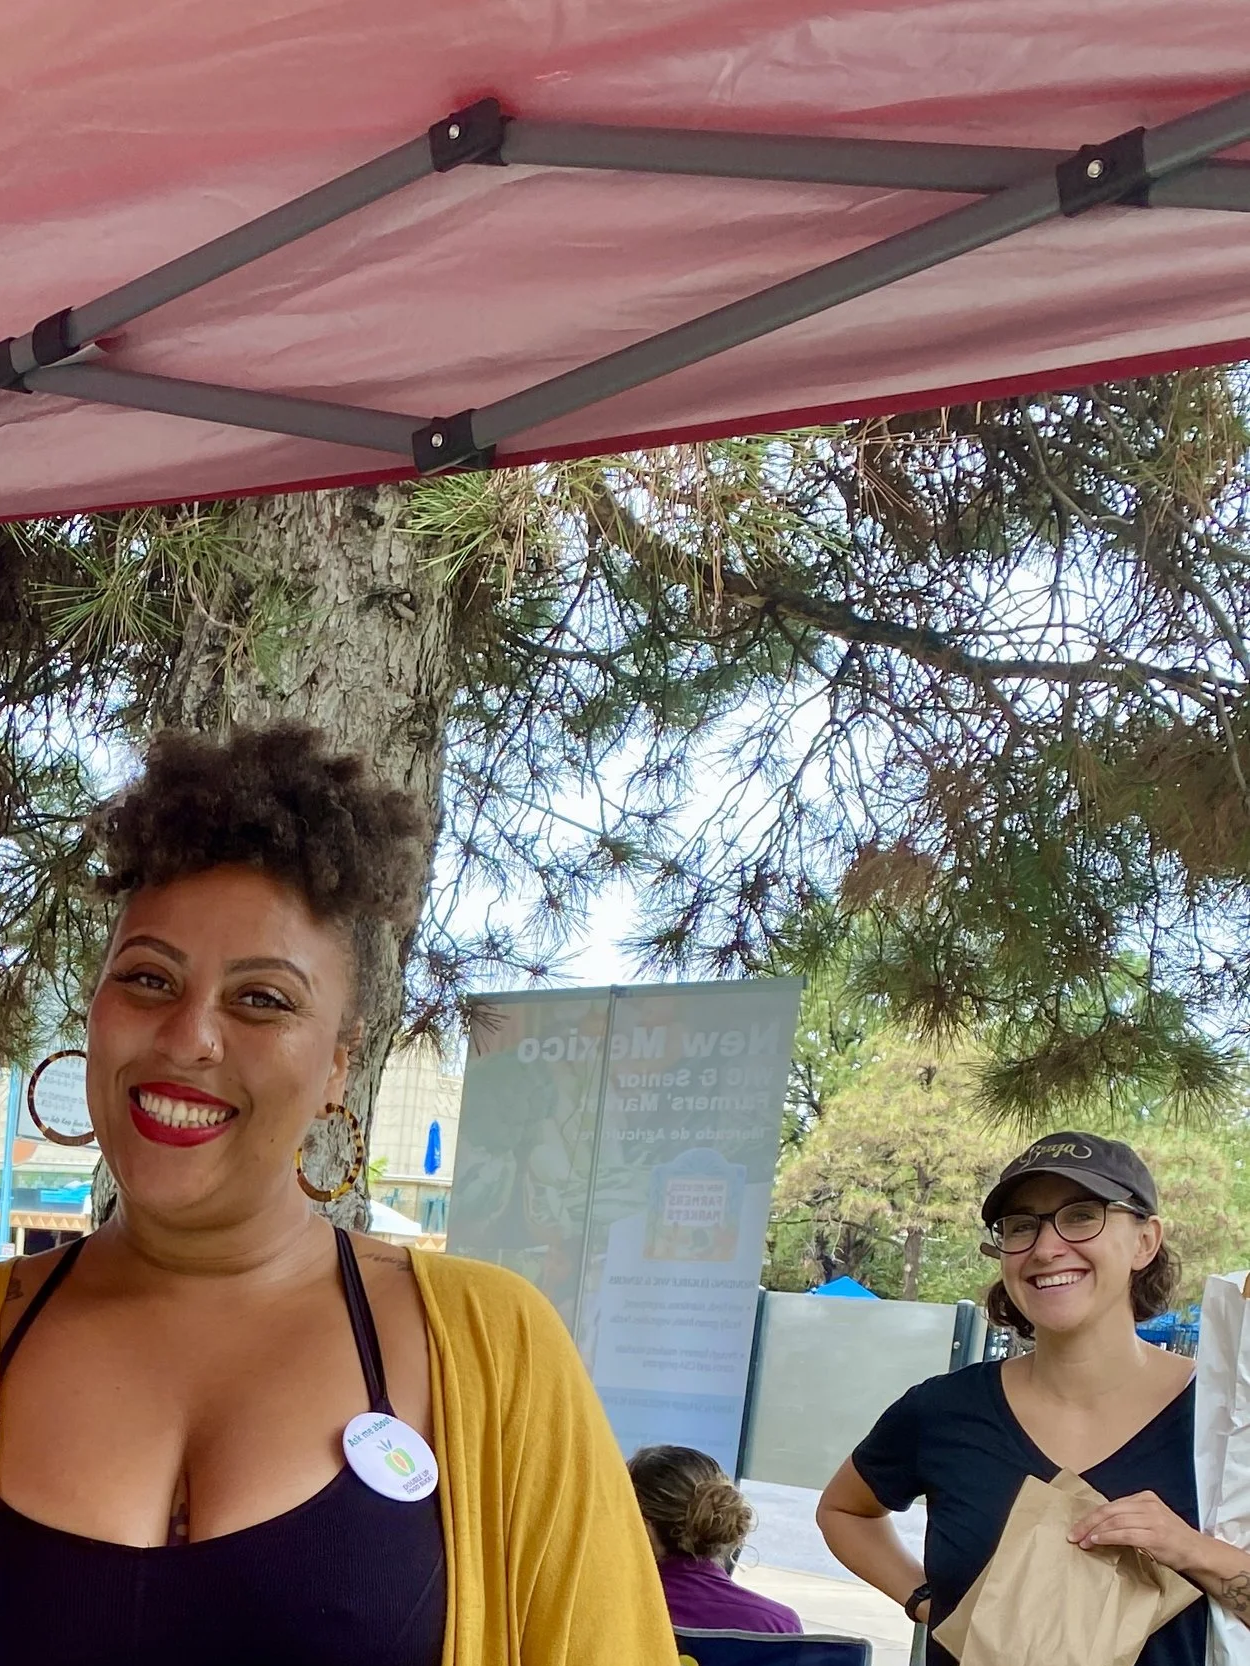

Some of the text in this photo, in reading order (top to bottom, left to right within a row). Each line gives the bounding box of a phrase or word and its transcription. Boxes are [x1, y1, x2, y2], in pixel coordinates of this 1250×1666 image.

[347, 1416, 392, 1447] Ask me about
